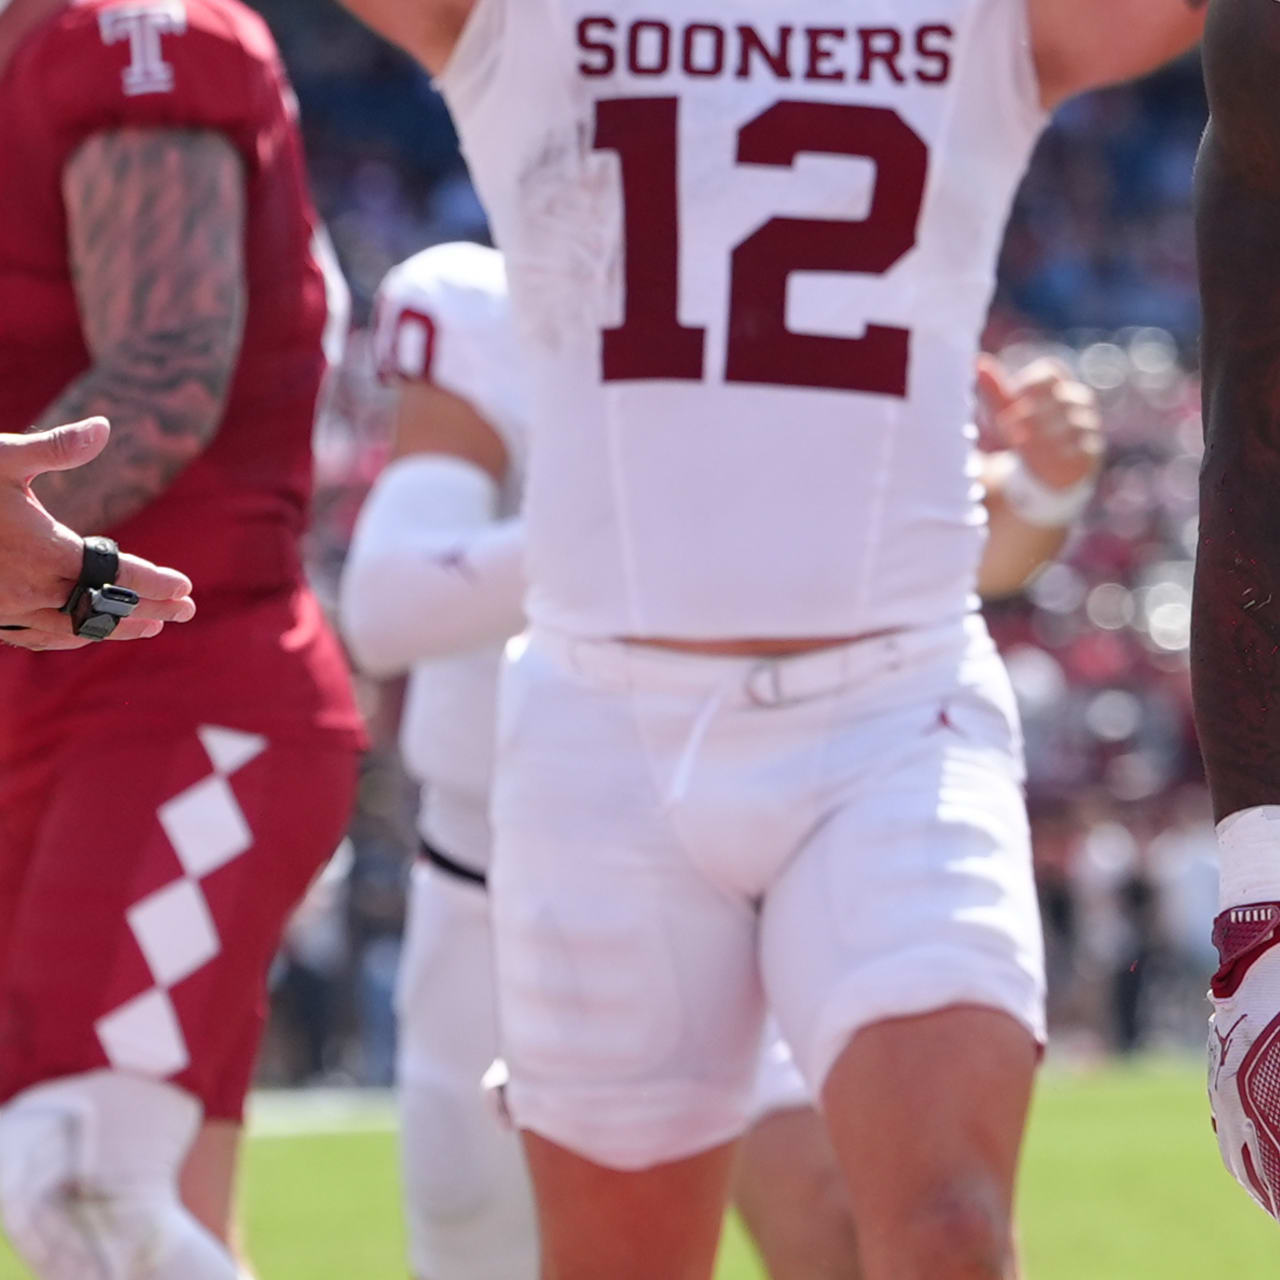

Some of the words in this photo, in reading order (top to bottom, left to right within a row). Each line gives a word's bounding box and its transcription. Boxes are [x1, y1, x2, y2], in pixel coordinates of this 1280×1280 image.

[97, 0, 187, 97] T
[576, 16, 955, 85] SOONERS
[592, 95, 929, 399] 12
